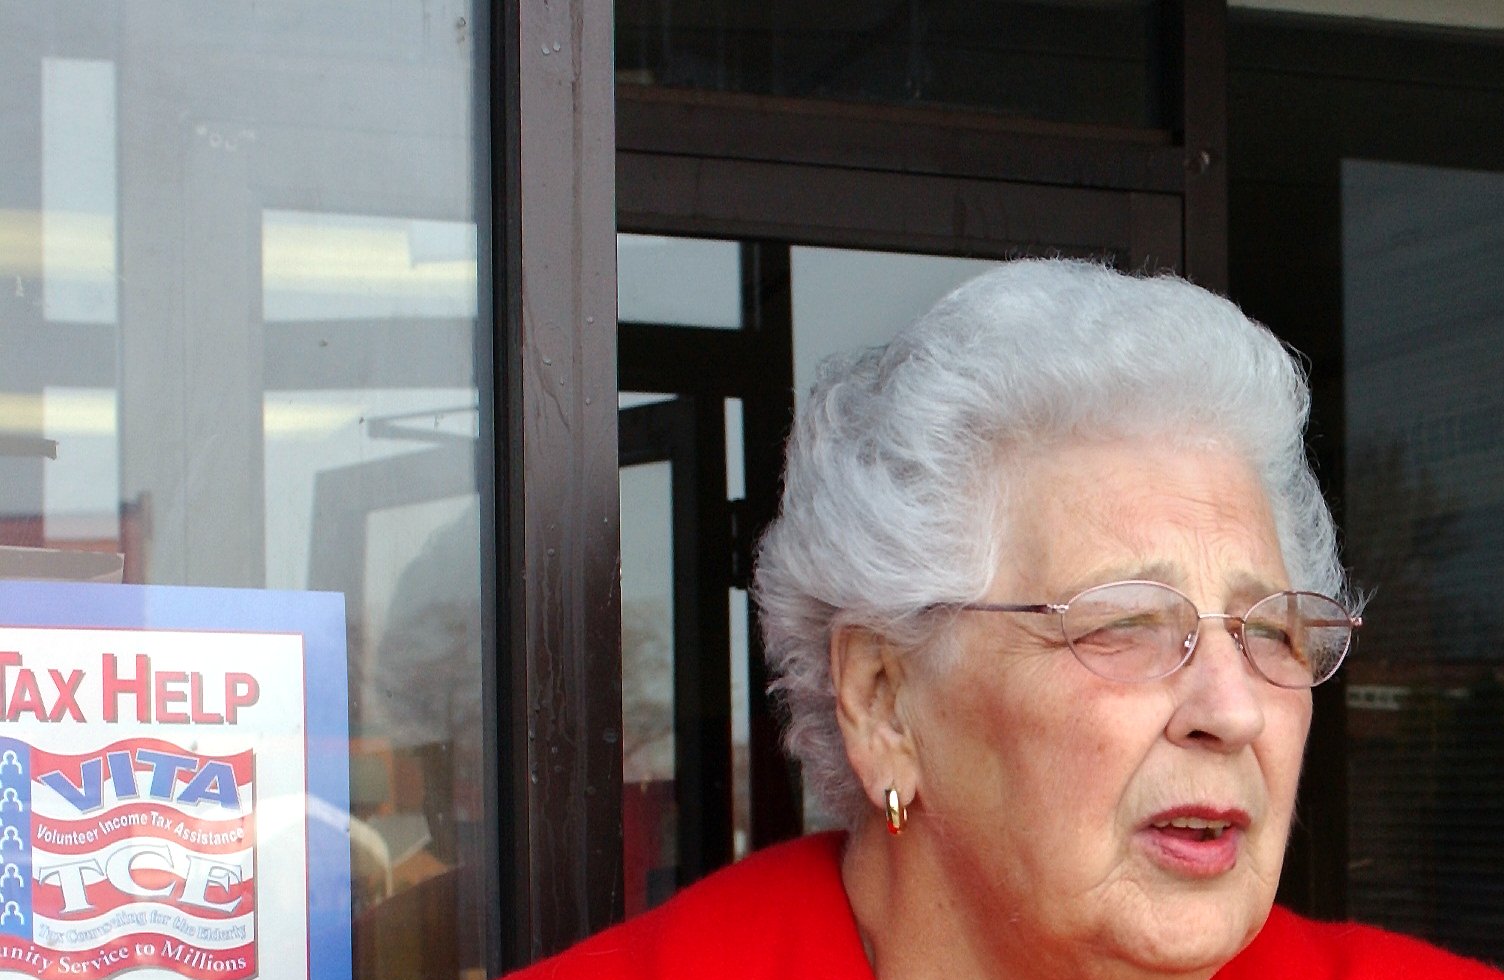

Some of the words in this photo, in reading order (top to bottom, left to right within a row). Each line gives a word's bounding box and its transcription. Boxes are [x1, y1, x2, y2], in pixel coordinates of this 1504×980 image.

[102, 653, 261, 725] HELP
[37, 747, 244, 815] VITA
[36, 824, 100, 847] Volunteer
[100, 810, 148, 836] Income
[150, 810, 173, 831] Tax
[174, 821, 246, 847] Assistance
[38, 843, 244, 915] TCE
[58, 945, 130, 975] Service
[135, 942, 156, 957] to
[161, 939, 247, 973] Millions
